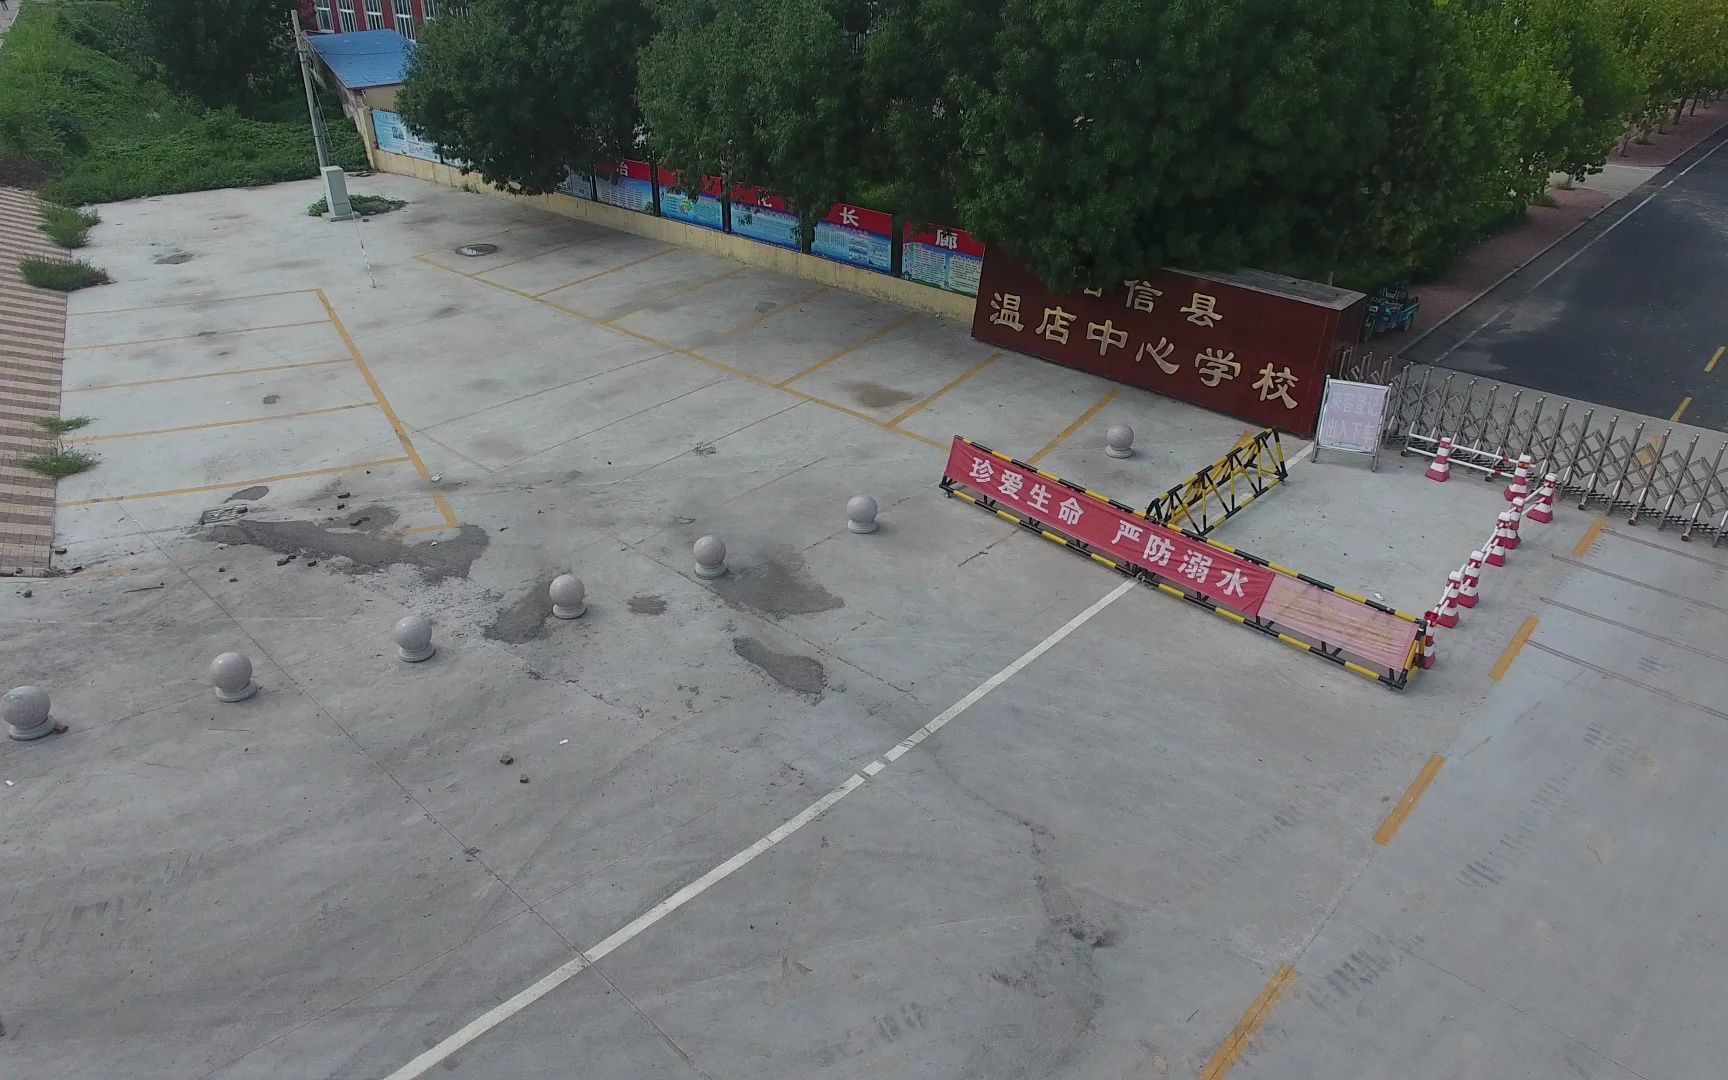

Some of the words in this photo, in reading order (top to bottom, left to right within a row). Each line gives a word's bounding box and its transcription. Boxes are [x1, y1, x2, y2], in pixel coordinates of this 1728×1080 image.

[840, 206, 860, 227] 长
[1083, 279, 1224, 328] 信县
[989, 292, 1300, 409] 温店中心学校
[969, 456, 1084, 526] 珍爱生命
[1111, 519, 1249, 599] 严防溺水
